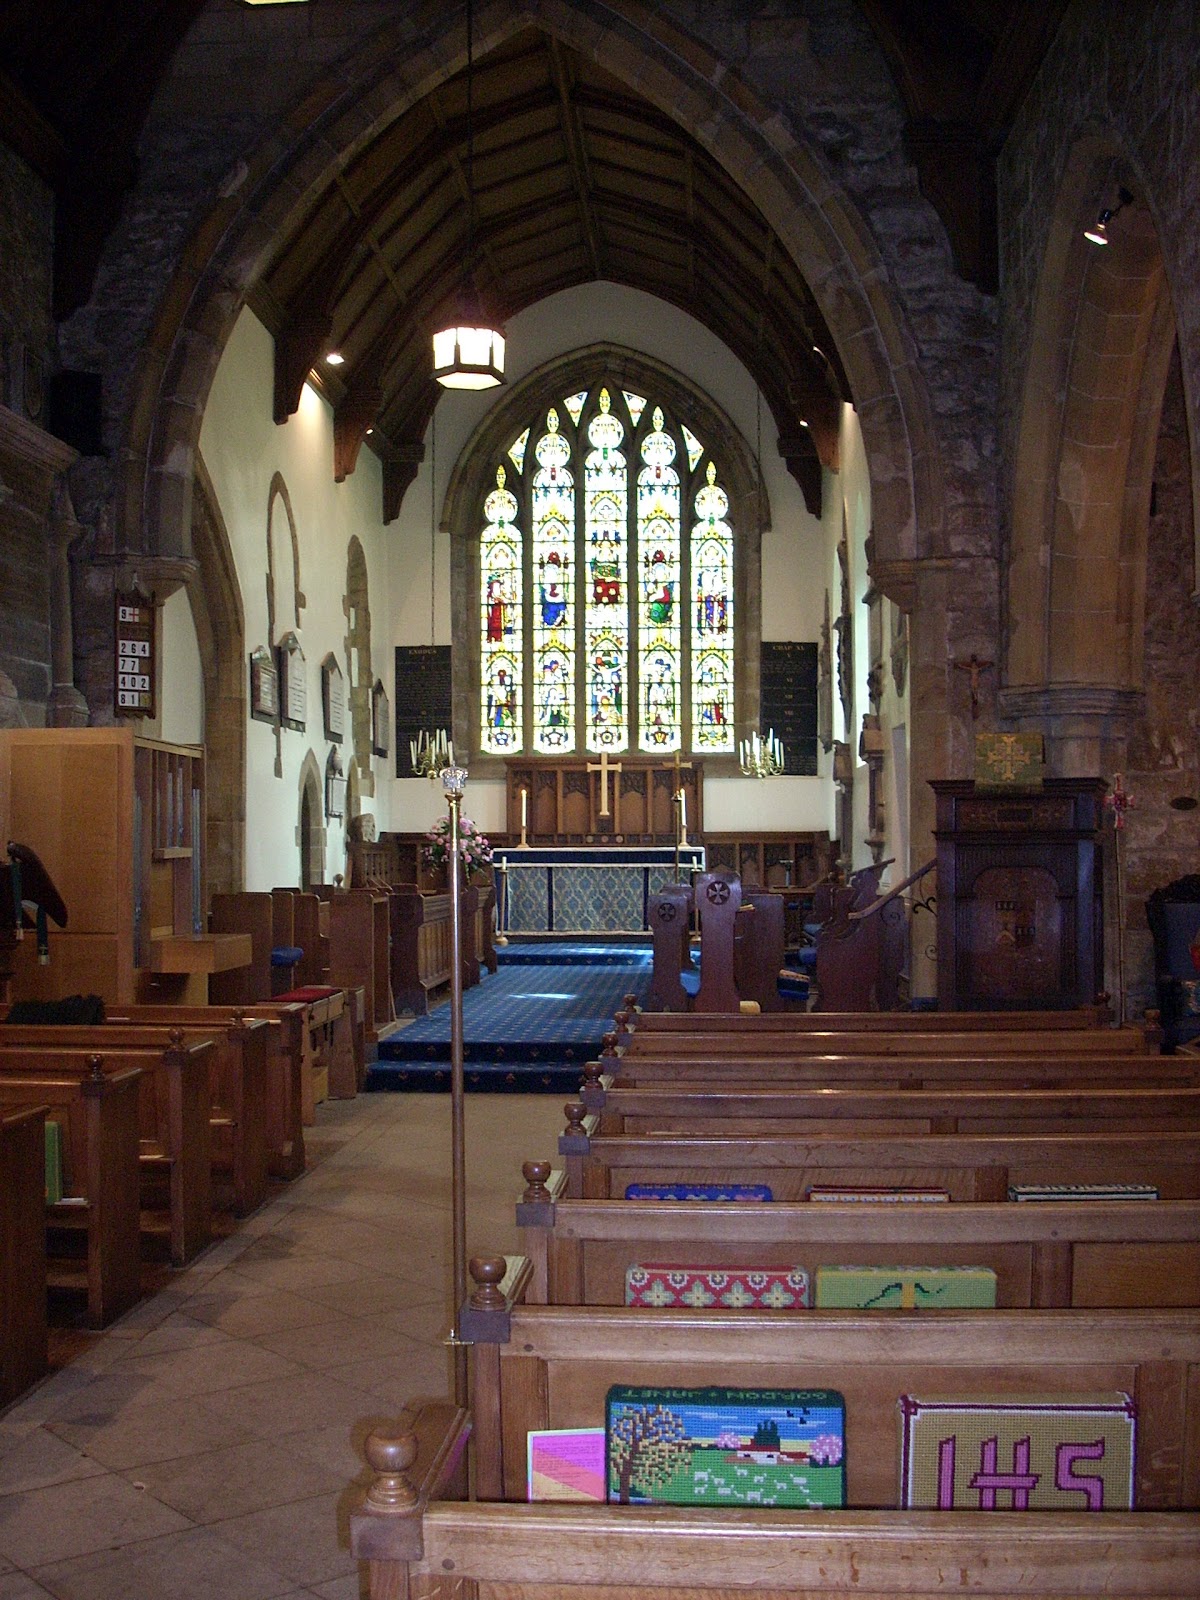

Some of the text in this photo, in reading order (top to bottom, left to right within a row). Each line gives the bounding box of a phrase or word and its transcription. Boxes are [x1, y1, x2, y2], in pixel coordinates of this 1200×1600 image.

[121, 643, 146, 654] 264
[121, 660, 136, 671] 77
[120, 676, 146, 688] 402
[120, 694, 135, 704] 81
[621, 1389, 701, 1399] JANET
[726, 1391, 828, 1401] GORDON
